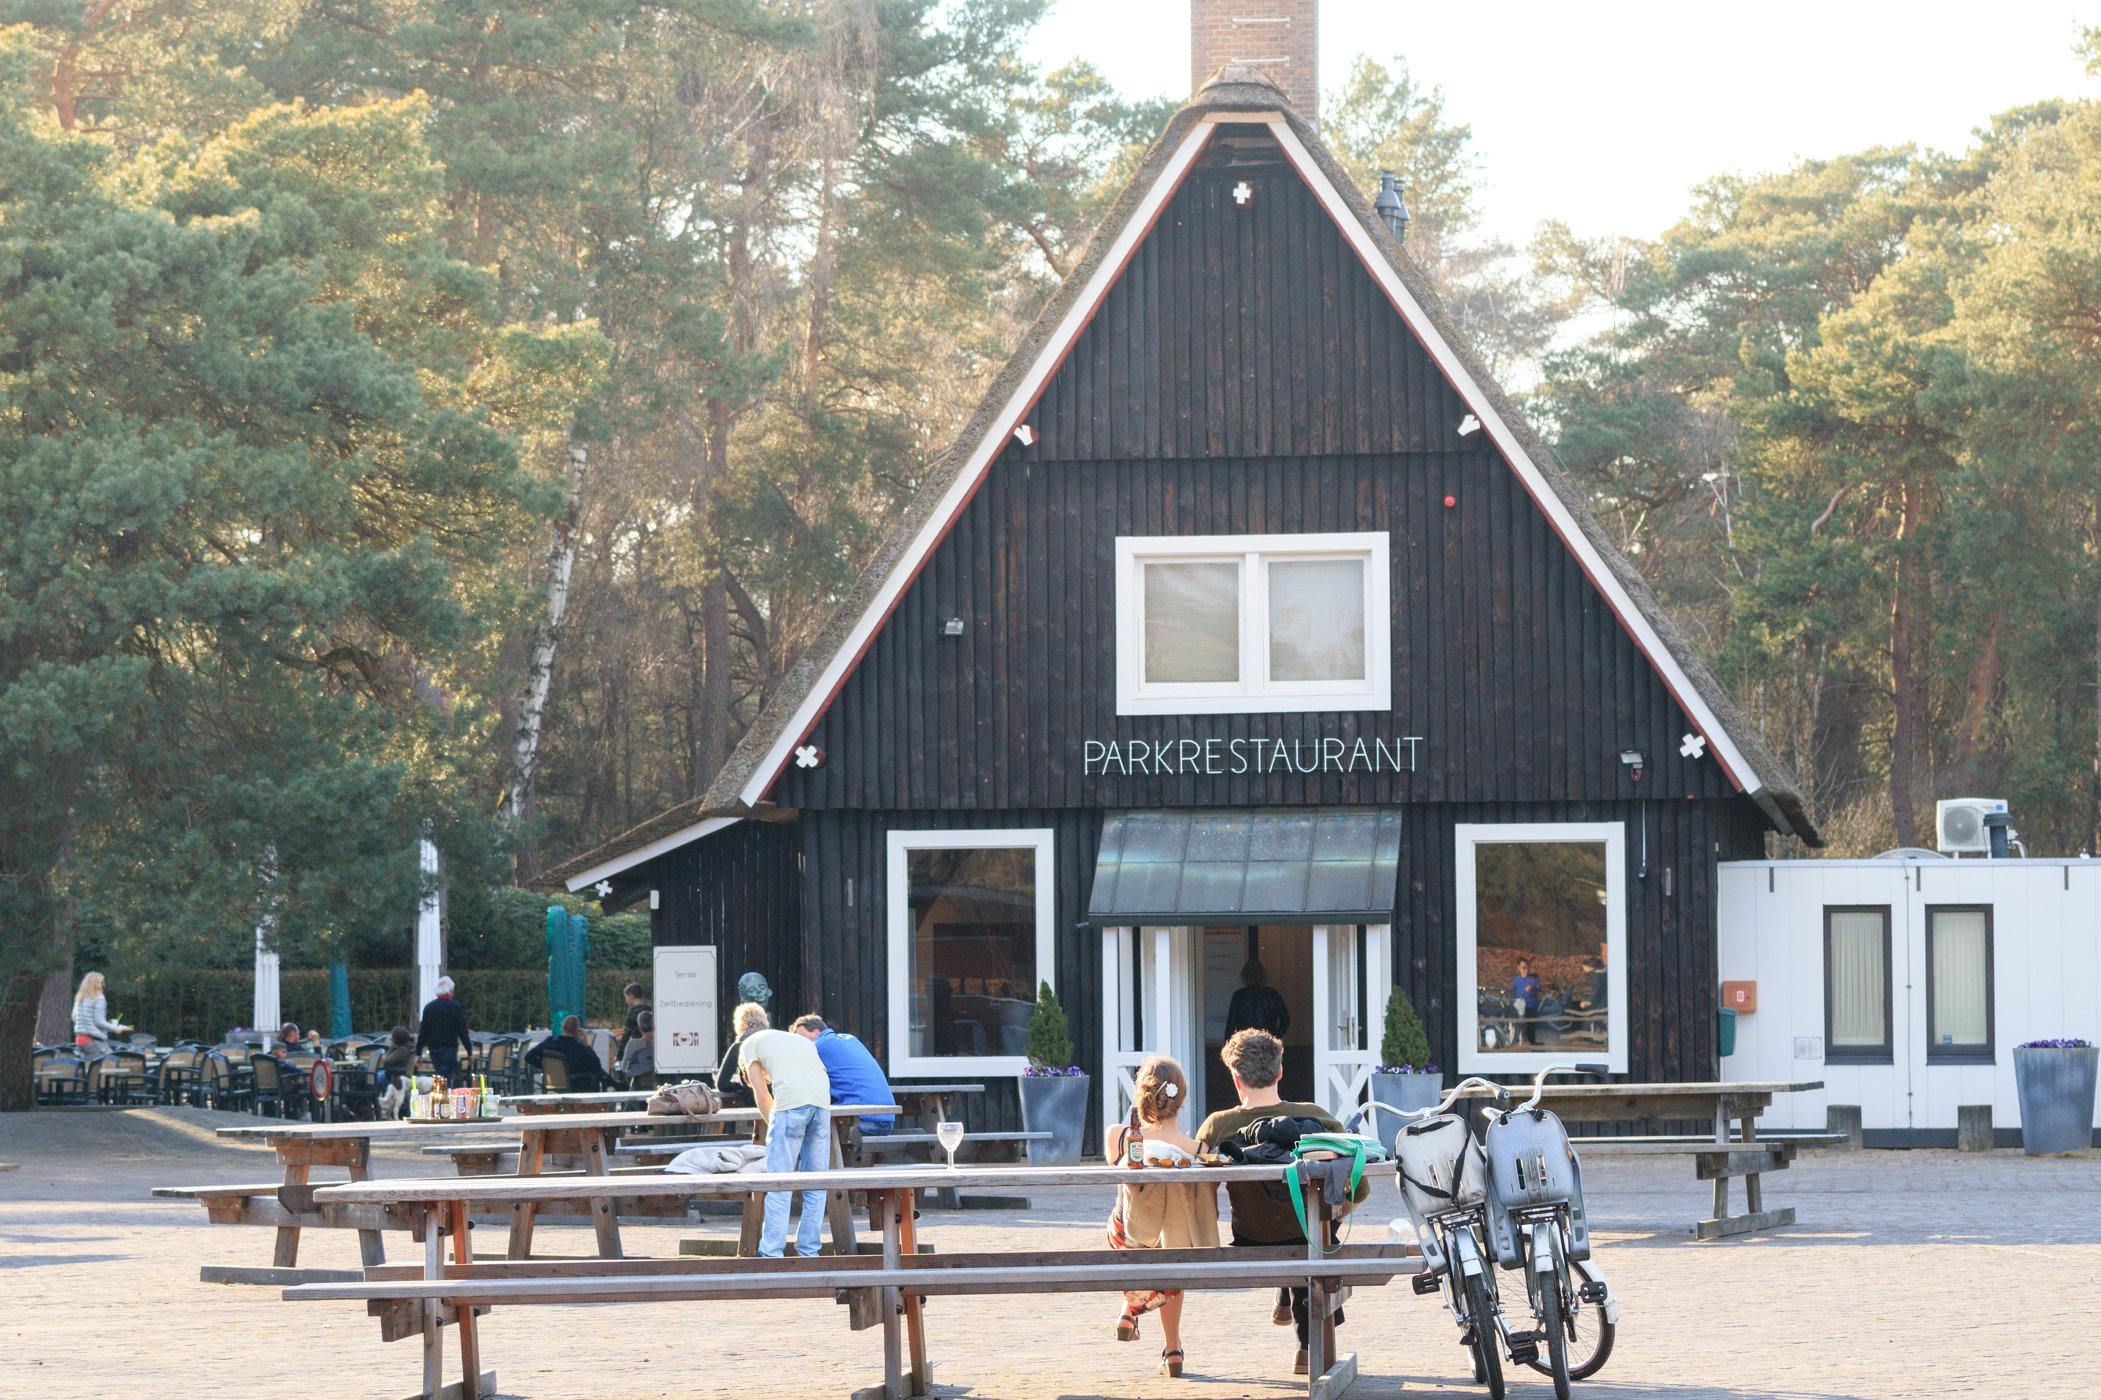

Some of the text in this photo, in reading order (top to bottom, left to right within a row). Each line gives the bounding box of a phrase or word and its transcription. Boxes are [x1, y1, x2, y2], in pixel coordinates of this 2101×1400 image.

[1083, 736, 1424, 776] PARKRESTAURANT
[674, 970, 697, 978] Terras
[659, 999, 713, 1009] Zelfbediening
